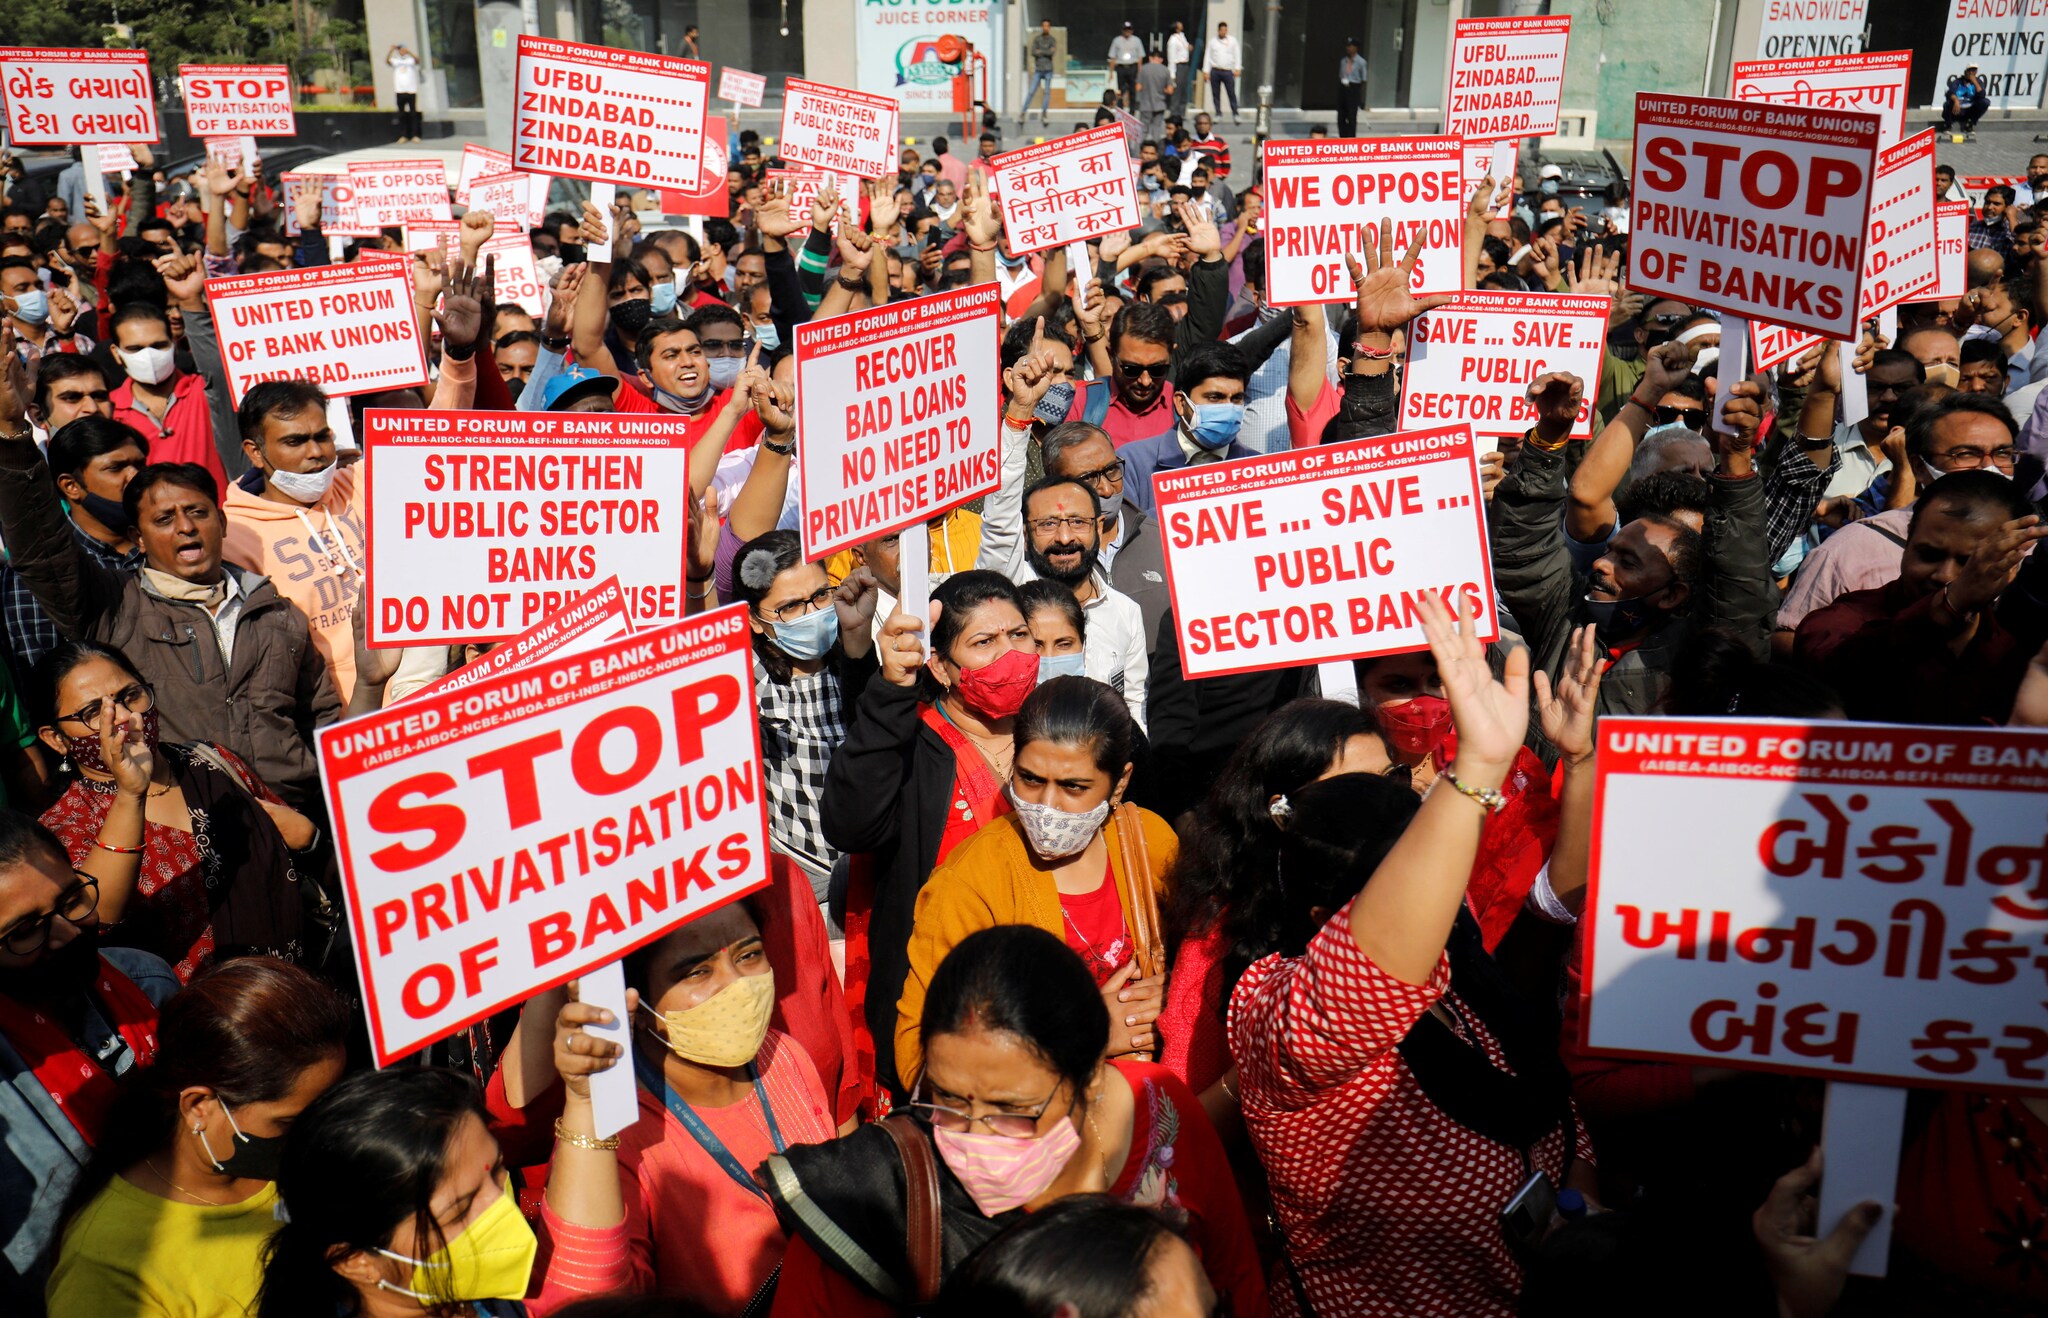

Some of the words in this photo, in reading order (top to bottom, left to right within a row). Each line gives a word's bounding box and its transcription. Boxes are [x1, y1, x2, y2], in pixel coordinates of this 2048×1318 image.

[876, 11, 920, 25] JUICE
[925, 10, 989, 23] CORNER
[1769, 0, 1863, 21] SANDWICH
[521, 40, 564, 52] UNITED
[568, 46, 607, 59] FORUM
[611, 53, 625, 61] OF
[630, 55, 660, 67] BANK
[664, 60, 707, 74] UNIONS
[1765, 34, 1853, 58] OPENING
[1952, 31, 2045, 57] OPENING
[1737, 63, 1776, 73] UNITED
[1778, 60, 1815, 70] FORUM
[1819, 59, 1831, 67] OF
[1834, 57, 1864, 66] BANK
[1867, 54, 1909, 63] UNIONS
[9, 67, 53, 98] બેંક
[69, 69, 146, 98] બચાવો
[190, 79, 284, 98] STOP
[1947, 72, 2039, 97] SORTLY
[18, 104, 58, 134] દેશ
[72, 104, 149, 134] બચાવો
[190, 102, 290, 113] PRIVATISATION
[196, 119, 218, 130] OF
[227, 119, 288, 130] BANKS
[793, 111, 832, 131] PUBLIC
[836, 120, 879, 141] SECTOR
[801, 96, 875, 123] STRENGTHEN
[1639, 99, 1686, 114] UNITED
[1691, 104, 1737, 119] FORUM
[1742, 109, 1761, 121] OF
[1766, 111, 1807, 127] BANK
[1812, 116, 1874, 134] UNIONS
[783, 142, 797, 157] DO
[801, 147, 823, 161] NOT
[826, 152, 882, 175] PRIVATISE
[817, 133, 854, 152] BANKS
[1268, 145, 1312, 156] UNITED
[1317, 144, 1358, 154] FORUM
[1361, 143, 1376, 152] OF
[1382, 142, 1412, 152] BANK
[1416, 141, 1460, 151] UNIONS
[1888, 135, 1932, 163] UNIONS
[1078, 151, 1112, 174] का
[1643, 137, 1862, 216] STOP
[1007, 177, 1125, 222] निजीकरण
[1270, 176, 1320, 208] WE
[1332, 171, 1458, 205] OPPOSE
[1018, 220, 1058, 245] बंध
[1075, 202, 1124, 232] करो
[1272, 219, 1458, 257] PRIVATIOATION
[1637, 200, 1857, 271] PRIVATISATION
[209, 279, 254, 291] UNITED
[258, 274, 300, 285] FORUM
[303, 271, 318, 280] OF
[323, 267, 355, 278] BANK
[358, 262, 402, 274] UNIONS
[1311, 263, 1340, 294] OF
[1639, 248, 1687, 283] OF
[1699, 260, 1842, 320] BANKS
[232, 299, 313, 326] UNITED
[319, 289, 394, 316] FORUM
[801, 323, 850, 345] UNITED
[855, 311, 897, 333] FORUM
[901, 307, 916, 321] OF
[921, 299, 952, 317] BANK
[955, 289, 997, 309] UNIONS
[1463, 295, 1503, 304] FORUM
[1507, 297, 1522, 305] OF
[1526, 297, 1558, 306] BANK
[1562, 299, 1607, 309] UNIONS
[229, 340, 255, 361] OF
[264, 331, 326, 357] BANK
[331, 320, 411, 348] UNIONS
[813, 307, 989, 359] (AIBEA-AIBOC-NCBE-AIBOA-BEFI-INBEF-INBOC-NOBW-NOBO)
[1415, 317, 1477, 345] SAVE
[1512, 320, 1572, 347] SAVE
[856, 333, 956, 391] RECOVER
[1461, 357, 1546, 383] PUBLIC
[846, 396, 892, 441] BAD
[900, 374, 966, 425] LOANS
[1408, 392, 1502, 419] SECTOR
[1509, 396, 1589, 422] BAS
[372, 418, 450, 431] UNITED
[457, 419, 526, 433] FORUM
[532, 420, 555, 434] OF
[562, 421, 613, 434] BANK
[618, 422, 686, 435] UNIONS
[392, 435, 669, 445] (AIBEA-AIBOC-NCBE-AIBOA-BEFI-INBEF-INBOC-NOBW-NOBO)
[842, 446, 875, 488] NO
[884, 427, 940, 475] NEED
[946, 416, 970, 453] TO
[1159, 471, 1226, 492] UNITED
[1232, 459, 1295, 480] FORUM
[1302, 454, 1325, 468] OF
[1333, 445, 1385, 464] BANK
[1391, 432, 1466, 454] UNIONS
[424, 454, 642, 491] STRENGTHEN
[1177, 451, 1452, 500] (AIBEA-AIBOC-NCBE-AIBOA-BEFI-INBEF-INBOC-NOBW-NOBO)
[808, 475, 927, 546] PRIVATISE
[934, 444, 998, 501] BANKS
[1170, 500, 1266, 548] SAVE
[1322, 475, 1423, 525] SAVE
[405, 501, 528, 538] PUBLIC
[540, 499, 659, 536] SECTOR
[488, 545, 595, 582] BANKS
[1254, 537, 1394, 591] PUBLIC
[382, 596, 429, 633] DO
[443, 593, 510, 630] NOT
[523, 585, 675, 626] PRISE
[1188, 602, 1338, 654] SECTOR
[1348, 582, 1483, 634] BANKS
[439, 661, 491, 692] FORUM
[494, 650, 513, 668] OF
[517, 622, 558, 656] BANK
[561, 586, 618, 629] UNIONS
[332, 710, 440, 758] UNITED
[450, 677, 541, 721] FORUM
[550, 664, 581, 688] OF
[590, 642, 654, 677] BANK
[661, 616, 743, 653] UNIONS
[363, 643, 728, 774] (AIBEA-AIBOC-NCBE-AIBOA-BEFI-INBEF-INBOC-NOBW-NOBO)
[1609, 732, 1747, 757] UNITED
[1757, 737, 1893, 762] FORUM
[1905, 742, 1957, 764] OF
[1970, 745, 2048, 769] BAN
[367, 673, 741, 873] STOP
[373, 760, 754, 957] PRIVATISATION
[401, 937, 498, 1019] OF
[527, 832, 751, 968] BANKS
